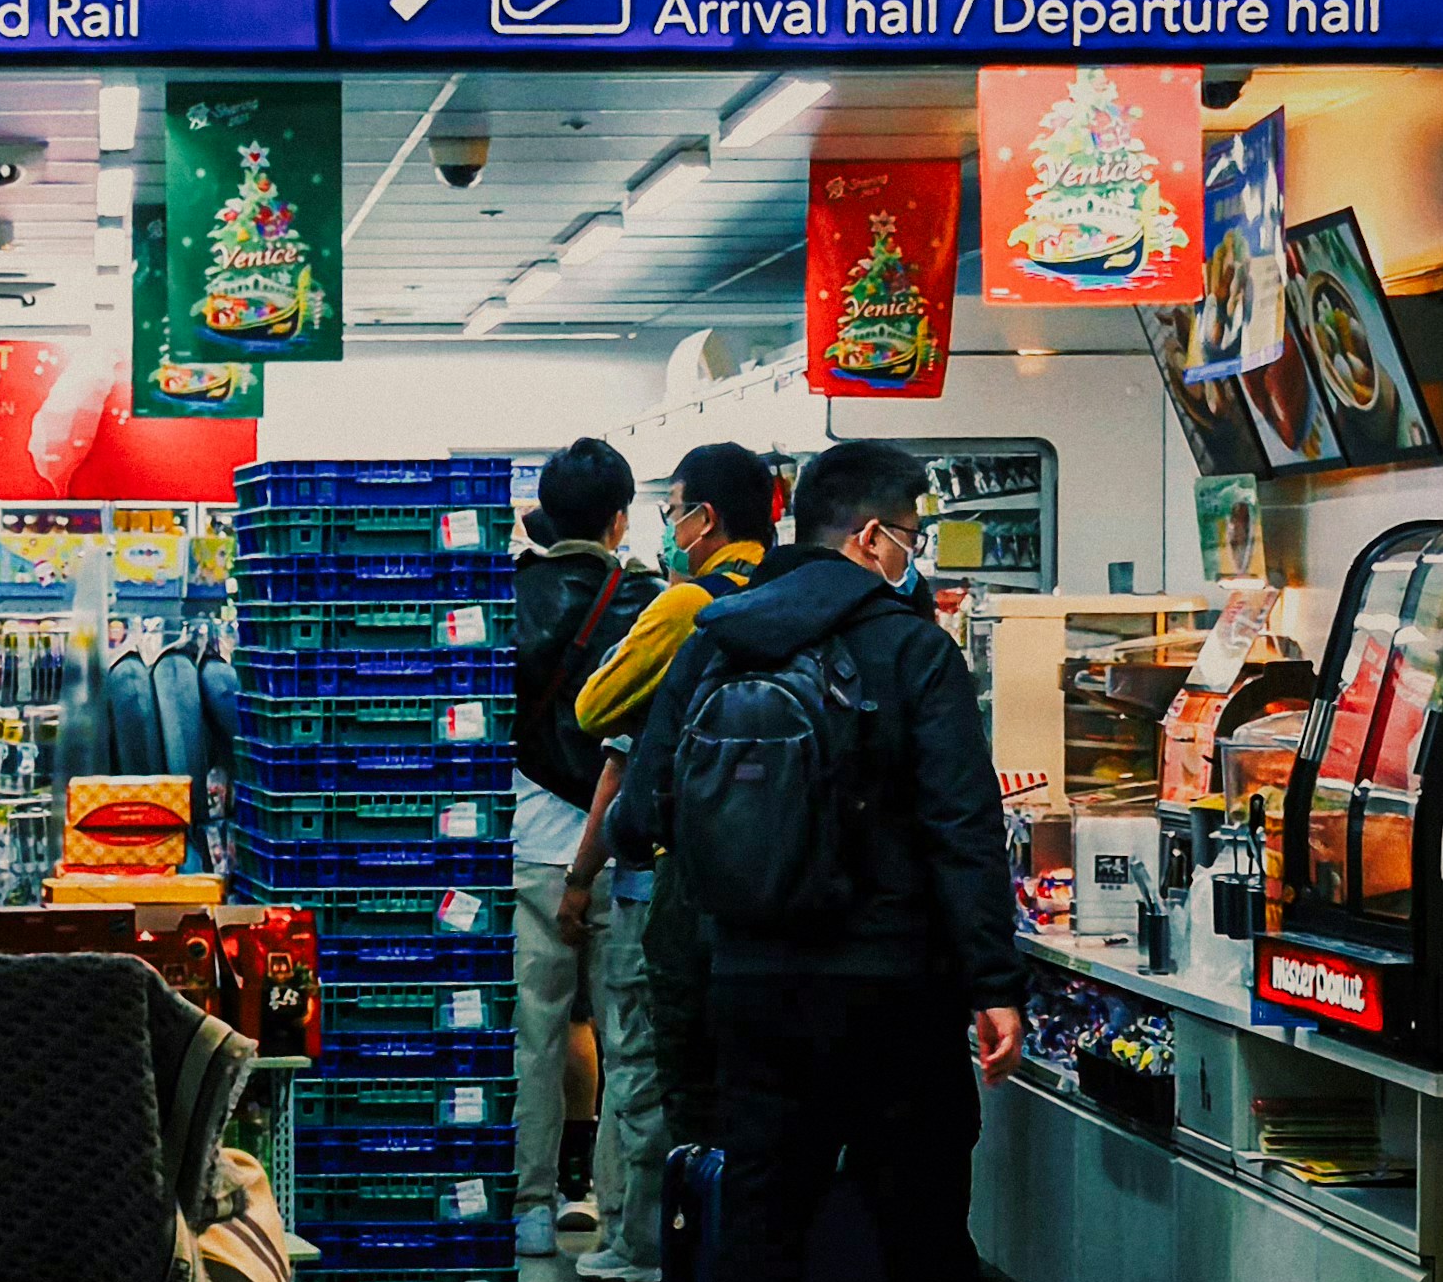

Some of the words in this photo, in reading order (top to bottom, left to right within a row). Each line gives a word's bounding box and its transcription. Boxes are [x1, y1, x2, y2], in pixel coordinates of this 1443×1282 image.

[1037, 156, 1144, 190] Venice
[215, 242, 299, 270] Venice
[849, 298, 917, 319] Venice
